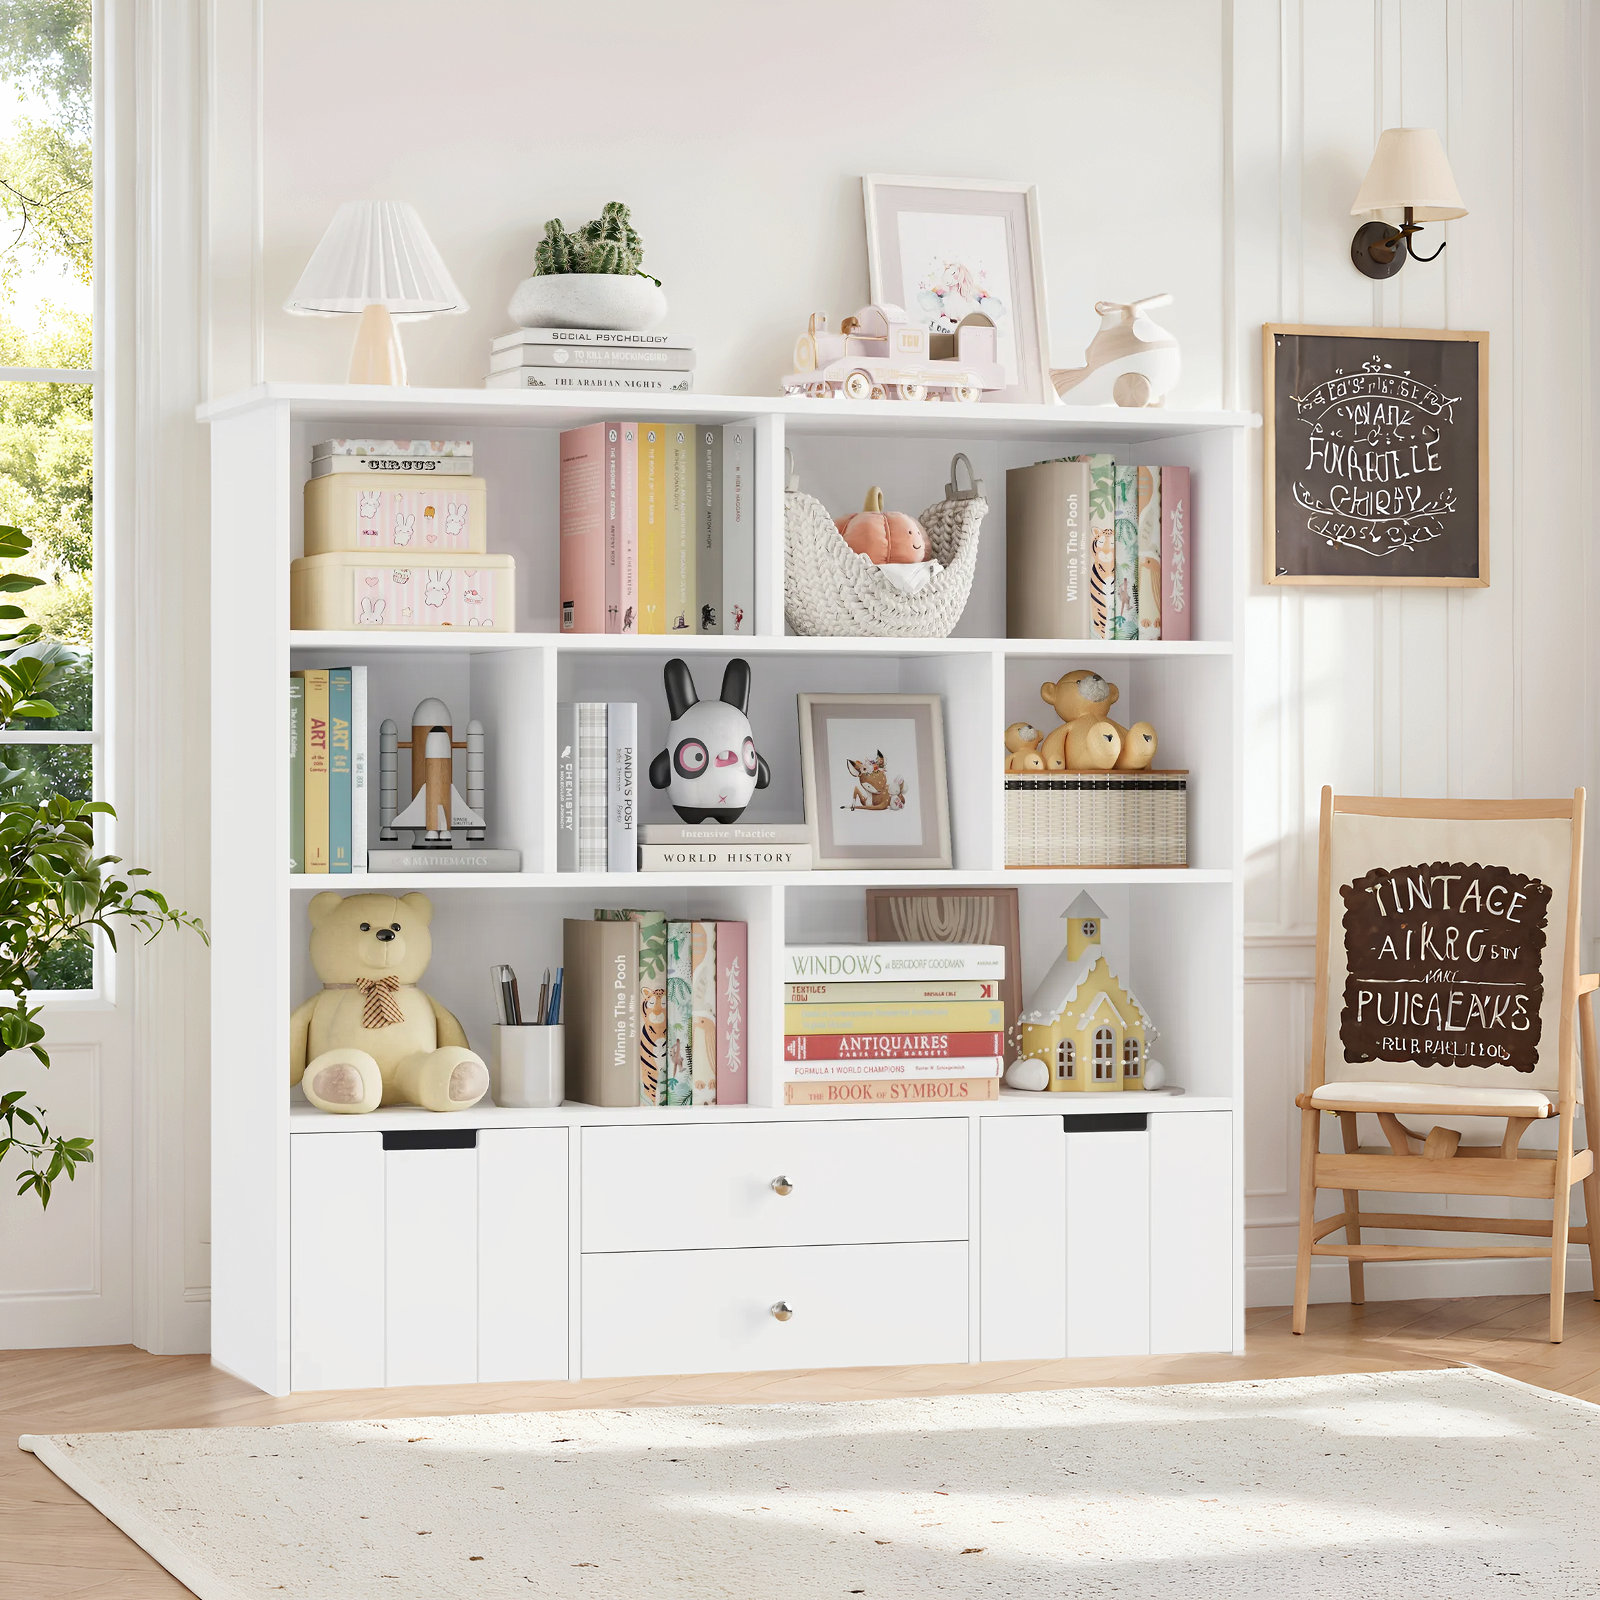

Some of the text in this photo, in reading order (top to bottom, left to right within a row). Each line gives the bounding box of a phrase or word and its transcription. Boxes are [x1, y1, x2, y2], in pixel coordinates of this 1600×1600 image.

[552, 332, 669, 343] SOCIAL PSYCHOLOGY
[573, 350, 585, 360] TO
[586, 351, 603, 361] KILL
[604, 352, 610, 361] A
[612, 352, 668, 363] MOCKINGBIRD
[554, 378, 663, 389] THE ARABIAN NIGHTS
[367, 459, 437, 471] CIRCUS
[1066, 493, 1078, 602] Winnie The Pooh
[310, 717, 326, 750] ART
[332, 717, 349, 750] ART
[624, 747, 633, 830] PANDA'S POSH
[565, 763, 573, 831] CHEMISTRY
[734, 829, 776, 839] Practice
[412, 856, 488, 866] MATHEMATICS
[663, 853, 793, 863] WORLD HISTORY
[792, 955, 882, 975] WINDOWS
[891, 960, 927, 969] BERGDORF
[928, 959, 965, 969] GOODMAN
[792, 985, 827, 994] TEXTILES
[614, 954, 626, 1067] Winnie The Pooh
[629, 1027, 635, 1038] by
[839, 1035, 948, 1052] ANTIQUAIRES
[794, 1067, 829, 1075] FORMULA
[836, 1066, 861, 1074] WORLD
[863, 1065, 905, 1074] CHAMPIONS
[808, 1093, 824, 1101] THE
[828, 1084, 873, 1101] BOOK
[890, 1082, 969, 1099] SYMBOLS
